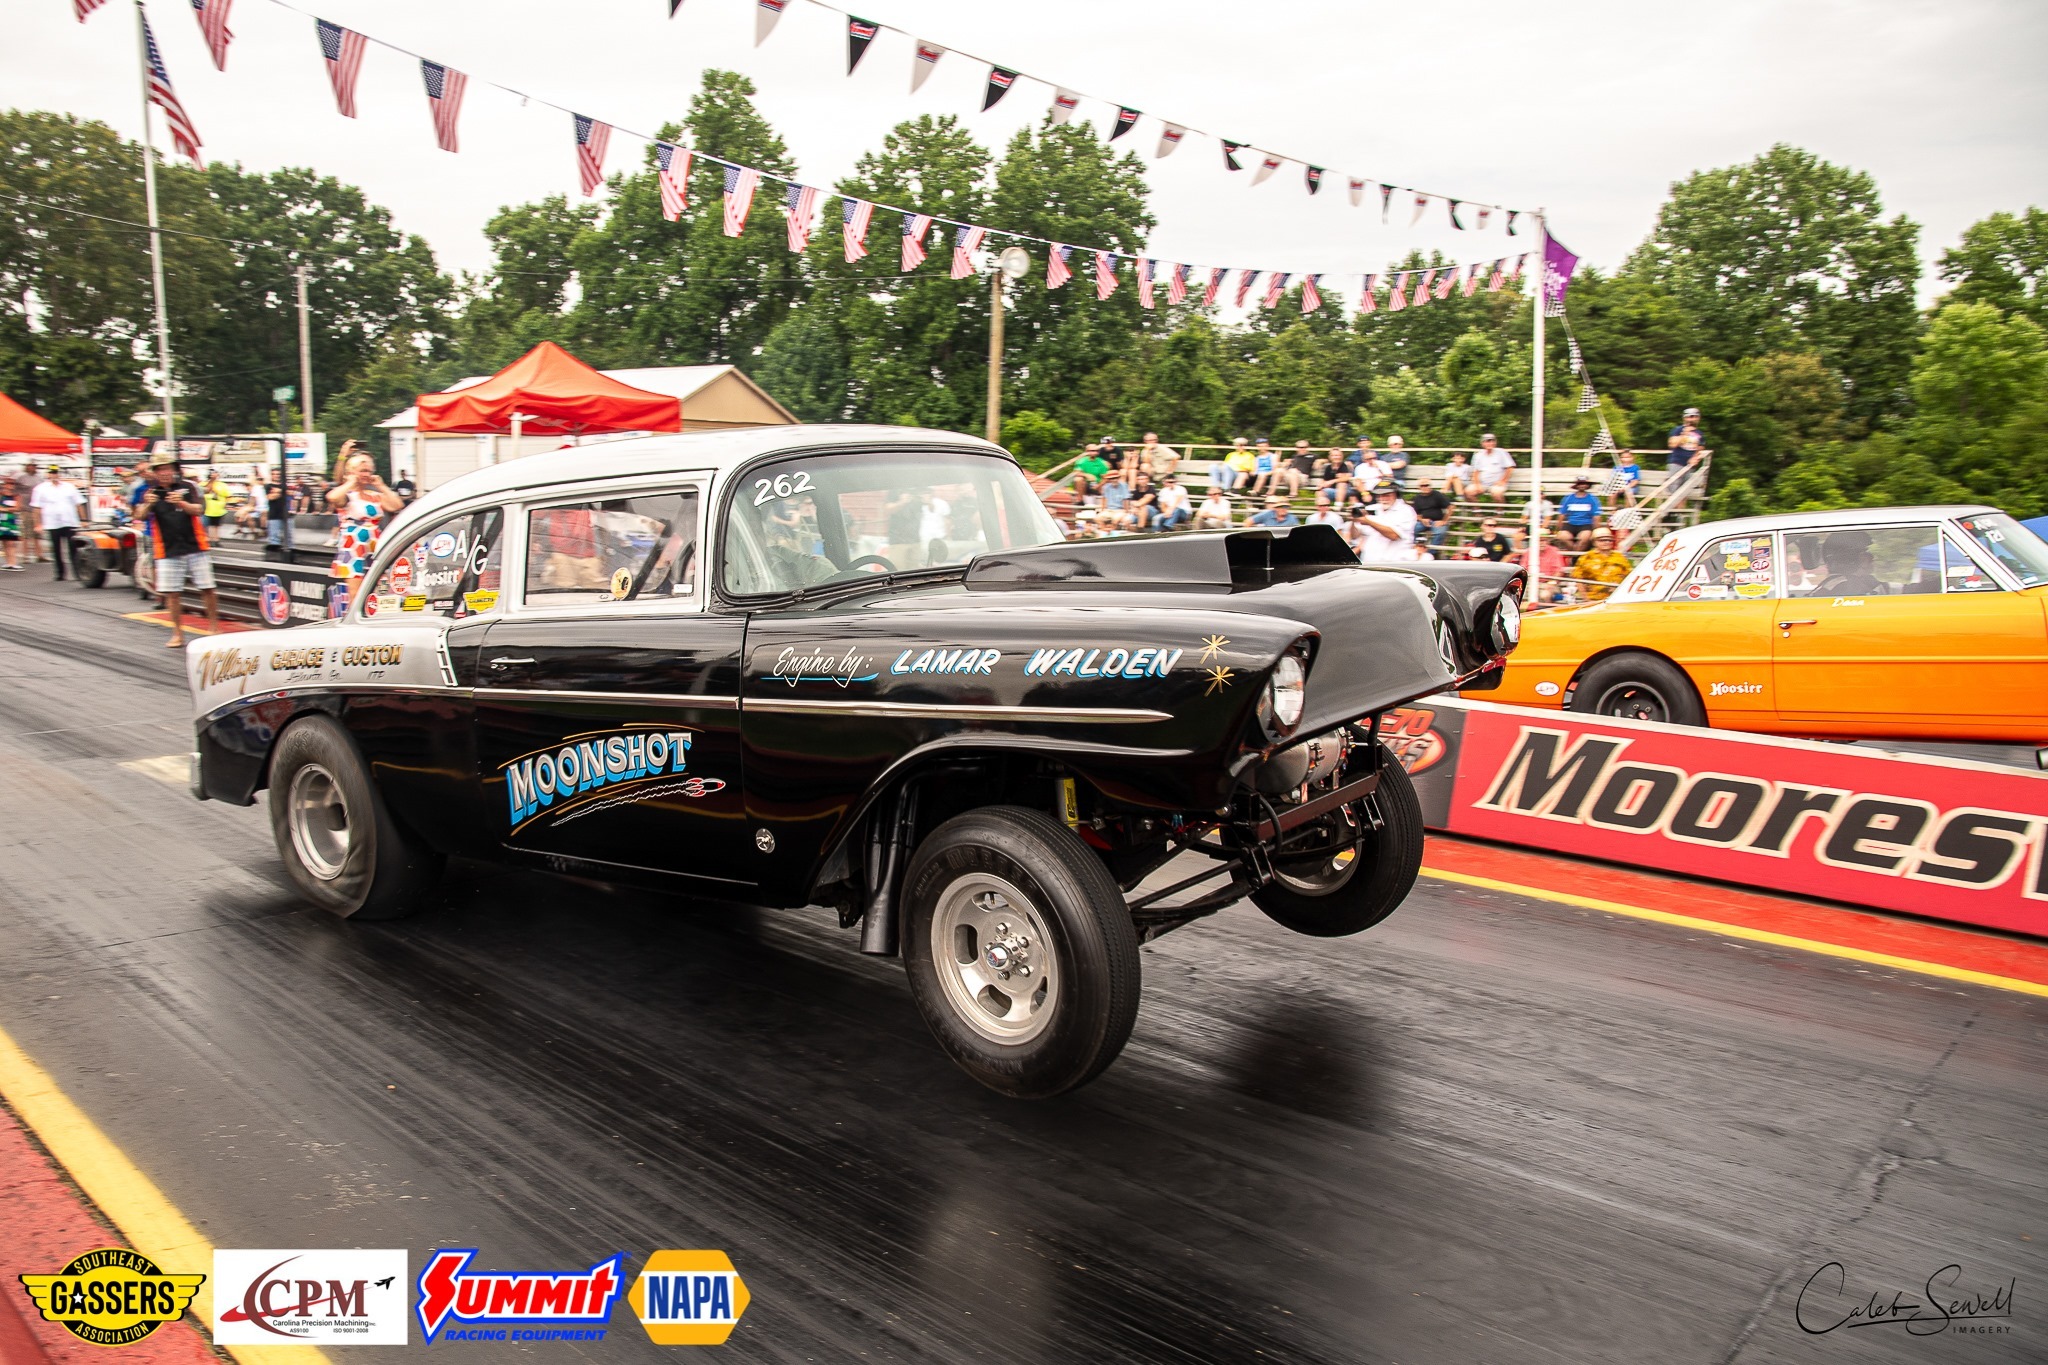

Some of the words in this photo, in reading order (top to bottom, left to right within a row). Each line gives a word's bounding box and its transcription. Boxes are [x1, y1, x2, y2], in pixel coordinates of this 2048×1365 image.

[753, 471, 817, 507] 262
[452, 529, 489, 576] A/G
[1653, 558, 1679, 571] GAS
[1626, 575, 1663, 594] 121
[197, 647, 261, 696] Village
[271, 647, 326, 670] GARAGE
[773, 646, 835, 687] Engine
[890, 648, 1001, 676] LAMAR
[1023, 648, 1184, 679] WALDEN
[1709, 681, 1763, 696] Hoosier
[506, 732, 692, 826] MOONSHOT
[1472, 724, 2048, 901] Moores
